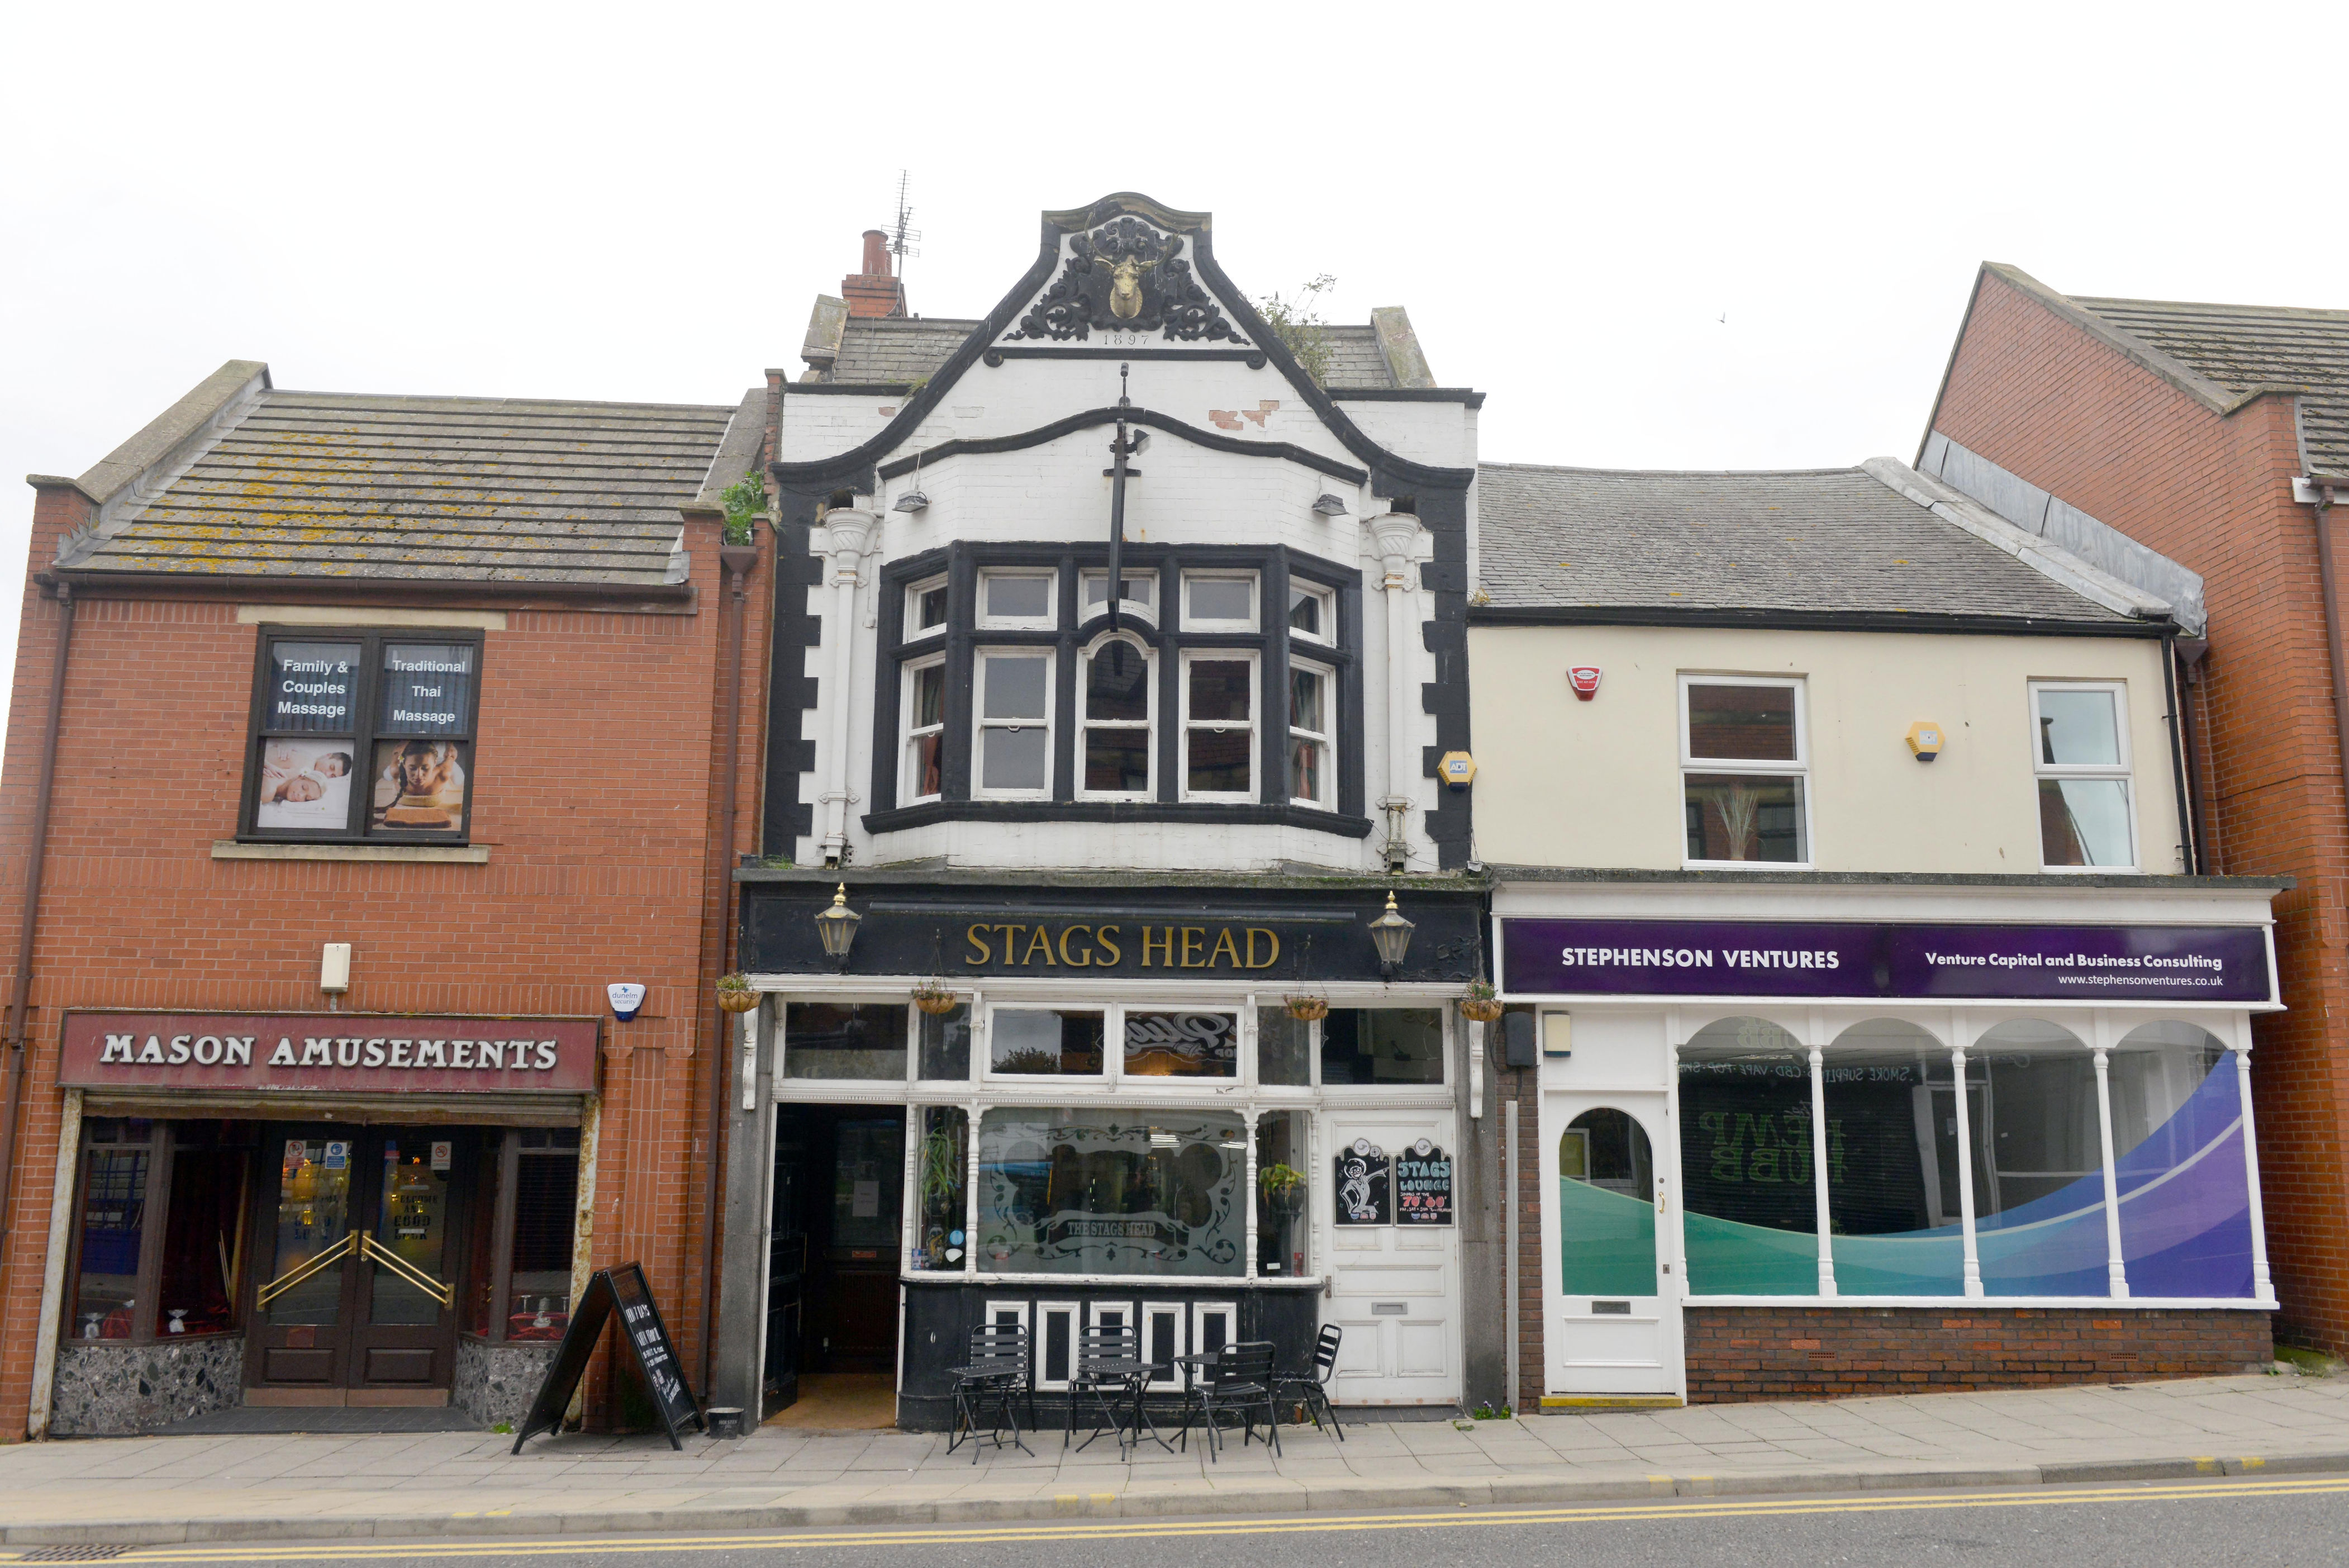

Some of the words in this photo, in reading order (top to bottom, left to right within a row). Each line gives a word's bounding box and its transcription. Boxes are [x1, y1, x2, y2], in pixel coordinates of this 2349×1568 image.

[1105, 335, 1149, 345] 1897
[283, 659, 332, 675] Family
[337, 661, 348, 673] &
[393, 660, 465, 672] Traditional
[283, 681, 345, 696] Couples
[412, 686, 441, 697] Thai
[278, 701, 346, 718] Massage
[393, 710, 455, 724] Massage
[1450, 763, 1467, 771] ADT
[964, 923, 1120, 967] STAGS
[1141, 925, 1280, 968] HEAD
[1562, 948, 1713, 967] STEPHENSON
[1723, 950, 1839, 969] VENTURES
[1925, 952, 1986, 966] Venture
[1989, 953, 2042, 969] Capital
[2045, 953, 2074, 967] and
[2077, 954, 2141, 968] Business
[2143, 954, 2222, 971] Consulting
[2058, 974, 2223, 987] www.stephensonventures.co.uk
[100, 1034, 256, 1066] MASON
[268, 1037, 558, 1071] AMUSEMENTS
[1397, 1161, 1451, 1177] STAGS
[1400, 1179, 1449, 1191] LOUNGE
[1067, 1222, 1090, 1236] THE
[1091, 1222, 1124, 1236] STAGS
[1125, 1222, 1156, 1237] HEAD
